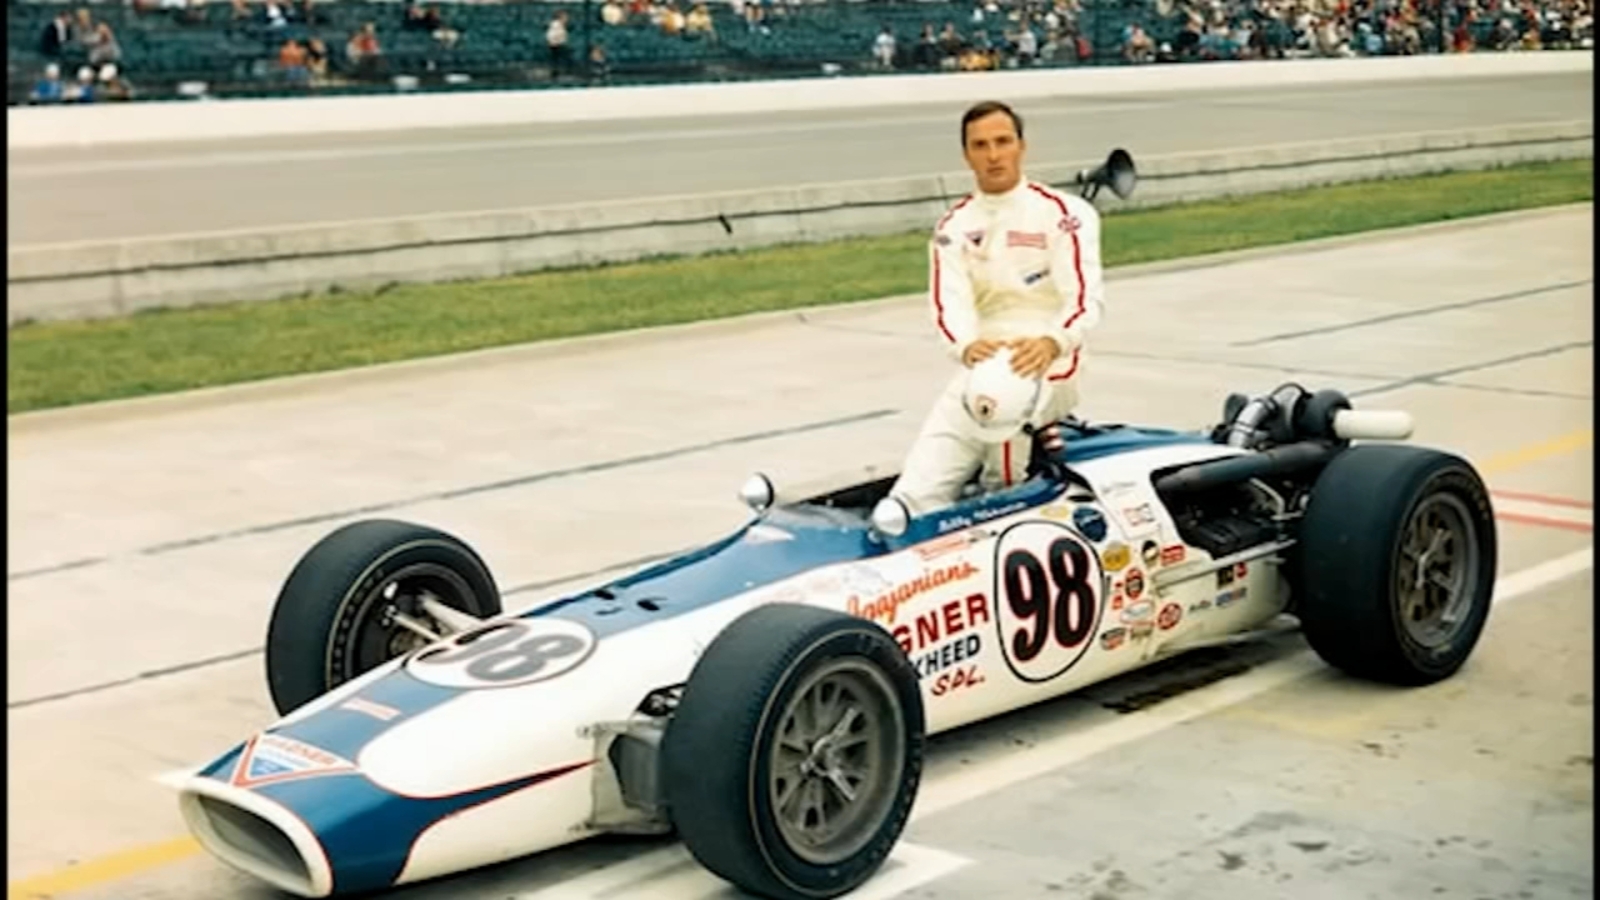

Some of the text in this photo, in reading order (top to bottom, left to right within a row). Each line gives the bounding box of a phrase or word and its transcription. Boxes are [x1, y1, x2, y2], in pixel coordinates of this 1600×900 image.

[893, 593, 989, 655] GNER
[1004, 537, 1096, 663] 98
[416, 621, 586, 682] 98
[914, 634, 980, 679] KHEED
